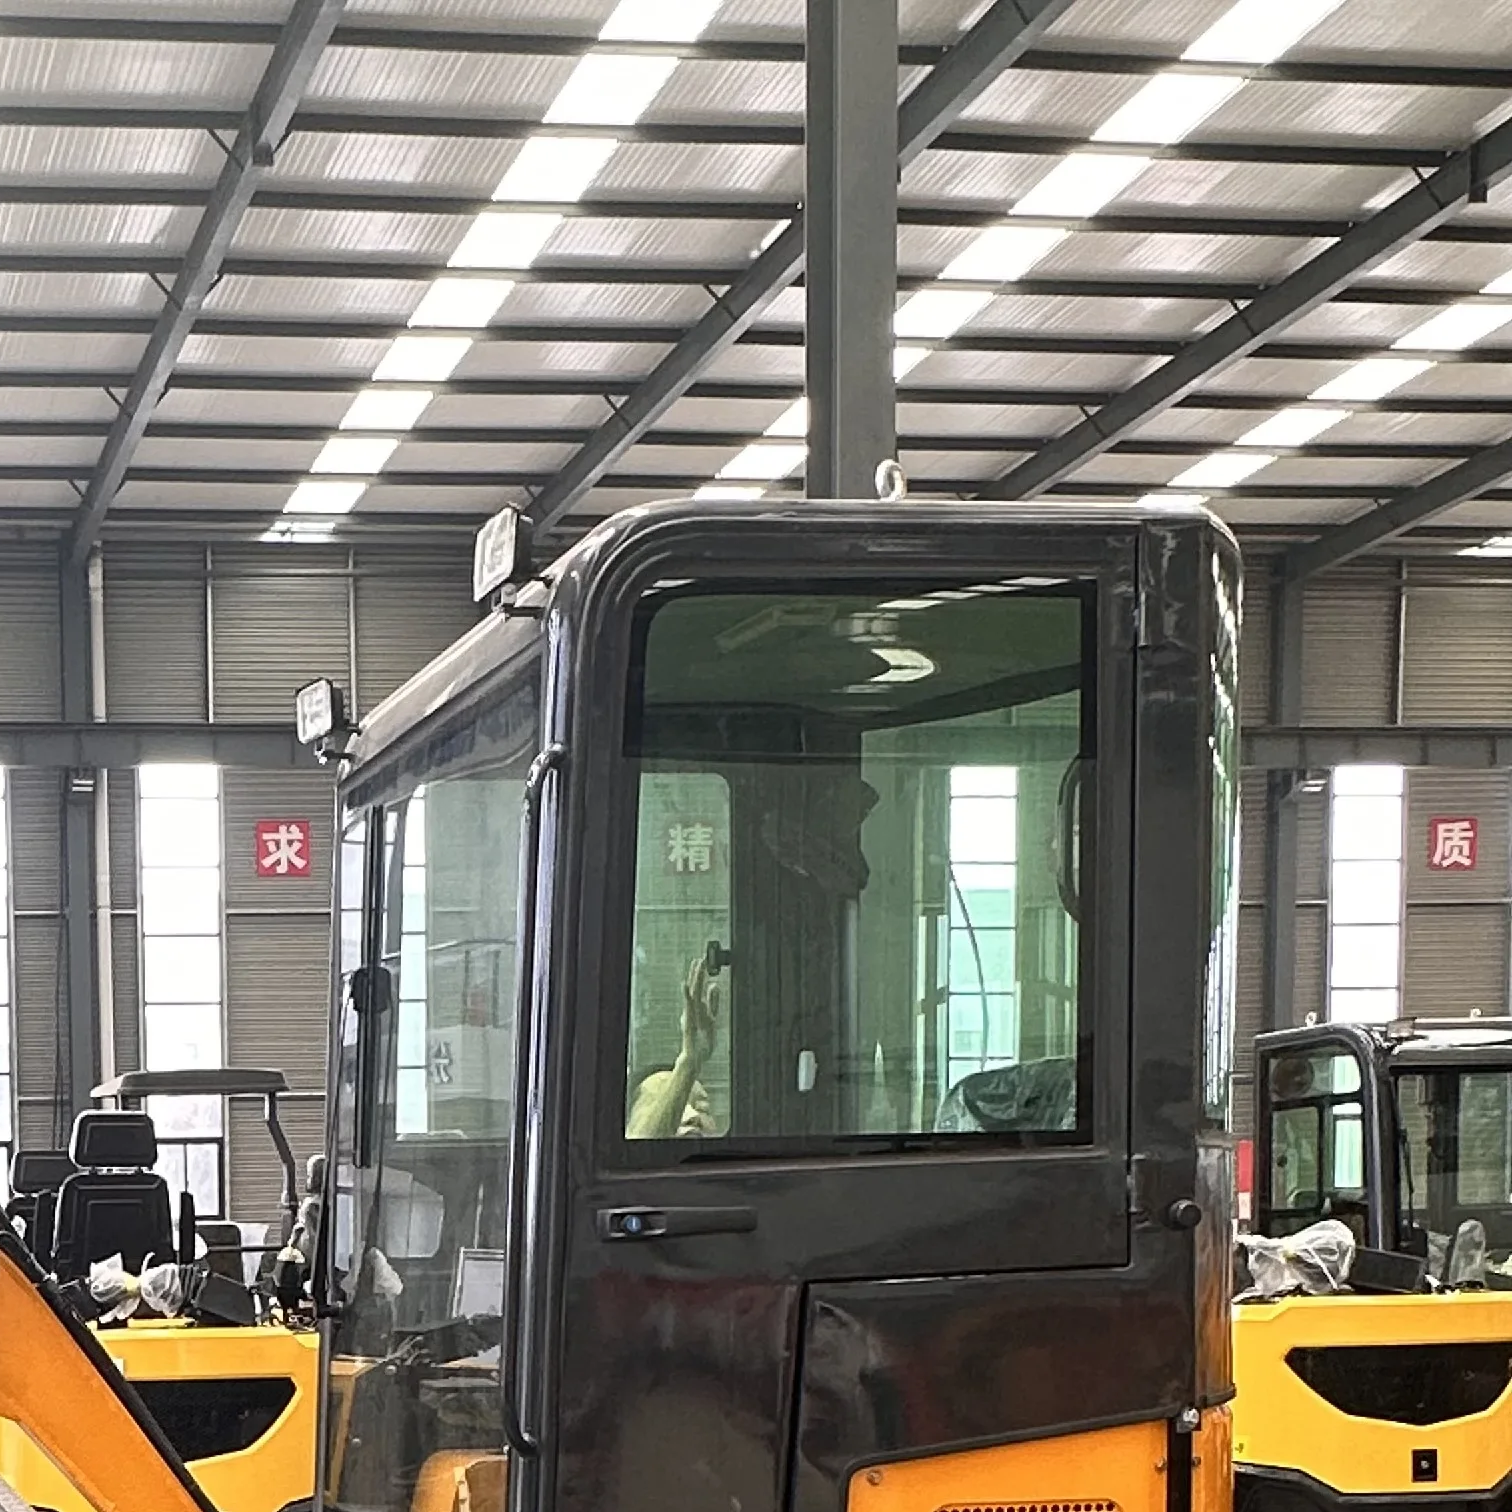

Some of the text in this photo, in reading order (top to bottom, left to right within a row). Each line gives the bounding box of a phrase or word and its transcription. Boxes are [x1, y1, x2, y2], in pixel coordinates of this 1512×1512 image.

[261, 824, 307, 874] 求
[667, 822, 714, 872] 精
[1432, 820, 1474, 868] 质
